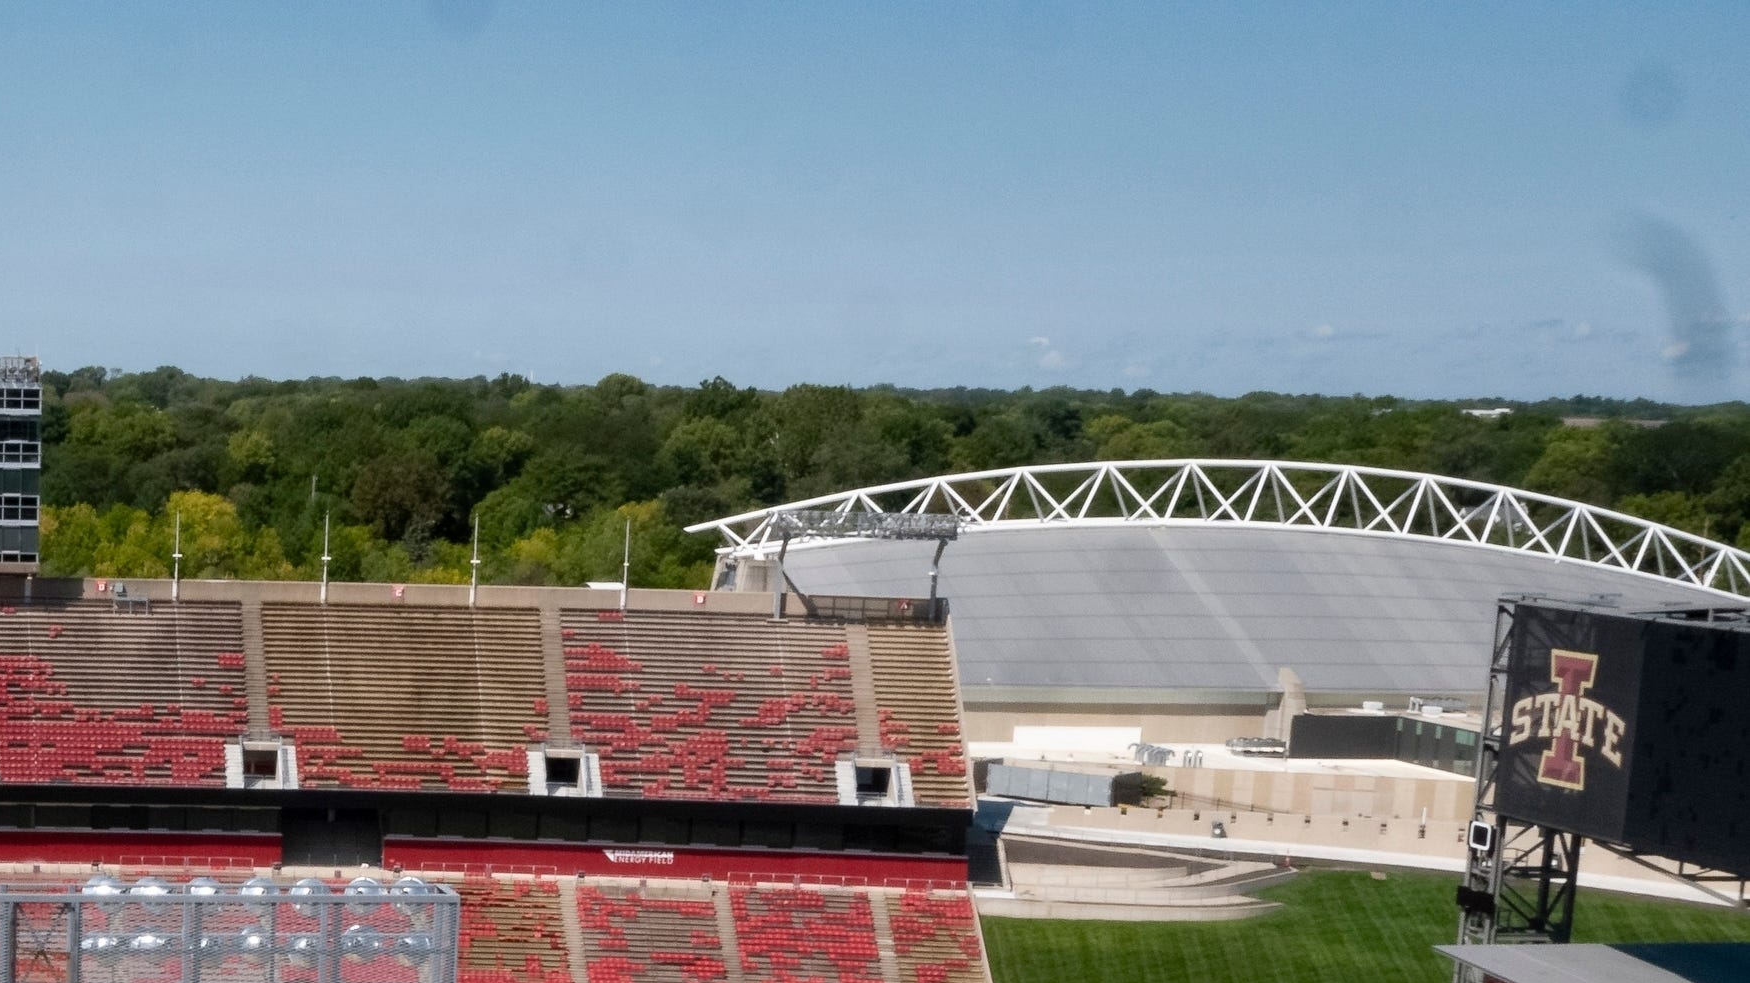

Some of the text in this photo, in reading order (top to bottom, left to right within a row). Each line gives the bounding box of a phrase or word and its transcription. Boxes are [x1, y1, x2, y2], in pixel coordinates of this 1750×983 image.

[1509, 692, 1626, 769] STATE
[614, 856, 675, 865] ENERGY FIELD
